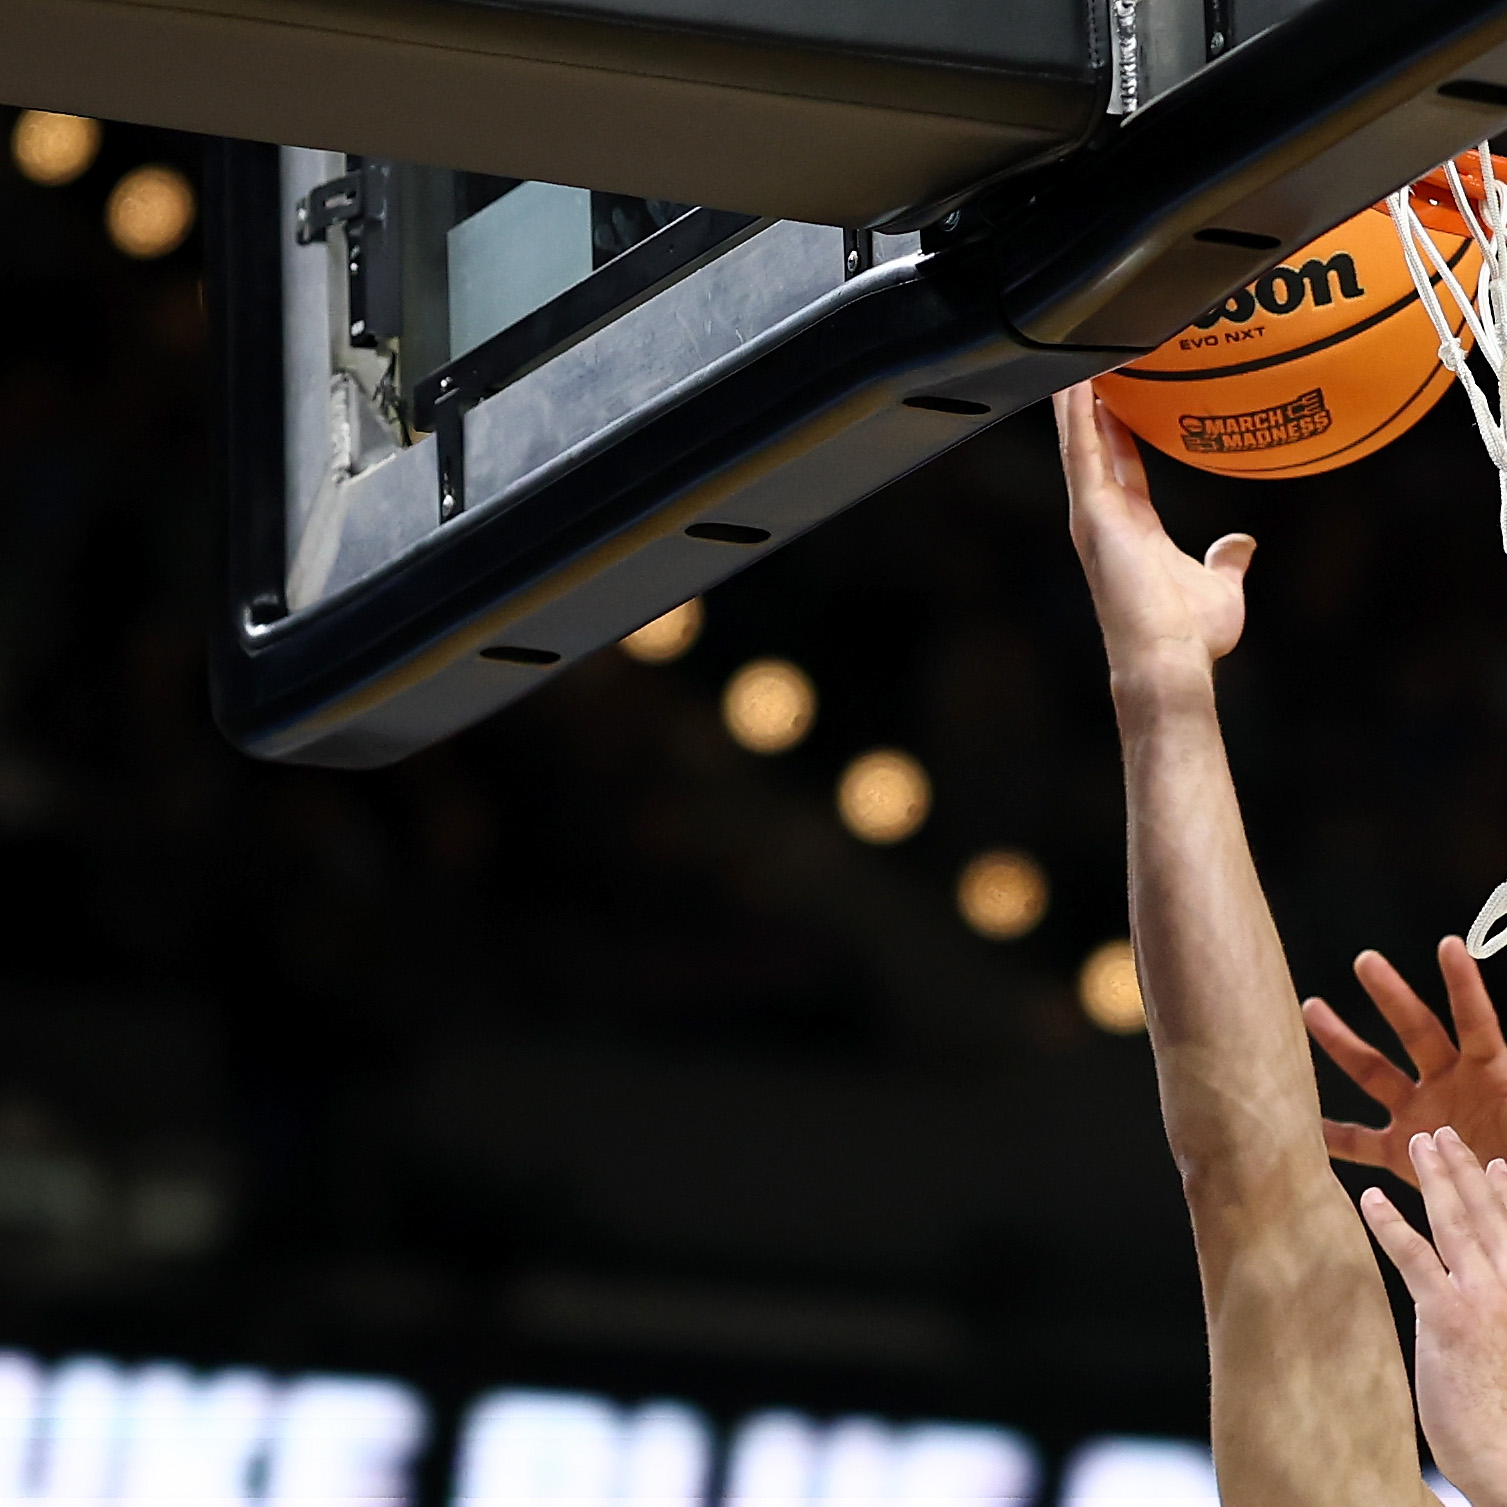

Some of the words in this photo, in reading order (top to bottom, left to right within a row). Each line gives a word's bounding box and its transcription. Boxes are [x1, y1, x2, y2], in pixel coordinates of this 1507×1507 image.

[1192, 252, 1365, 330] son
[1179, 334, 1219, 351] EVO
[1224, 327, 1266, 344] NXT
[1204, 408, 1285, 436] MARCH
[1221, 411, 1330, 449] MADNESS
